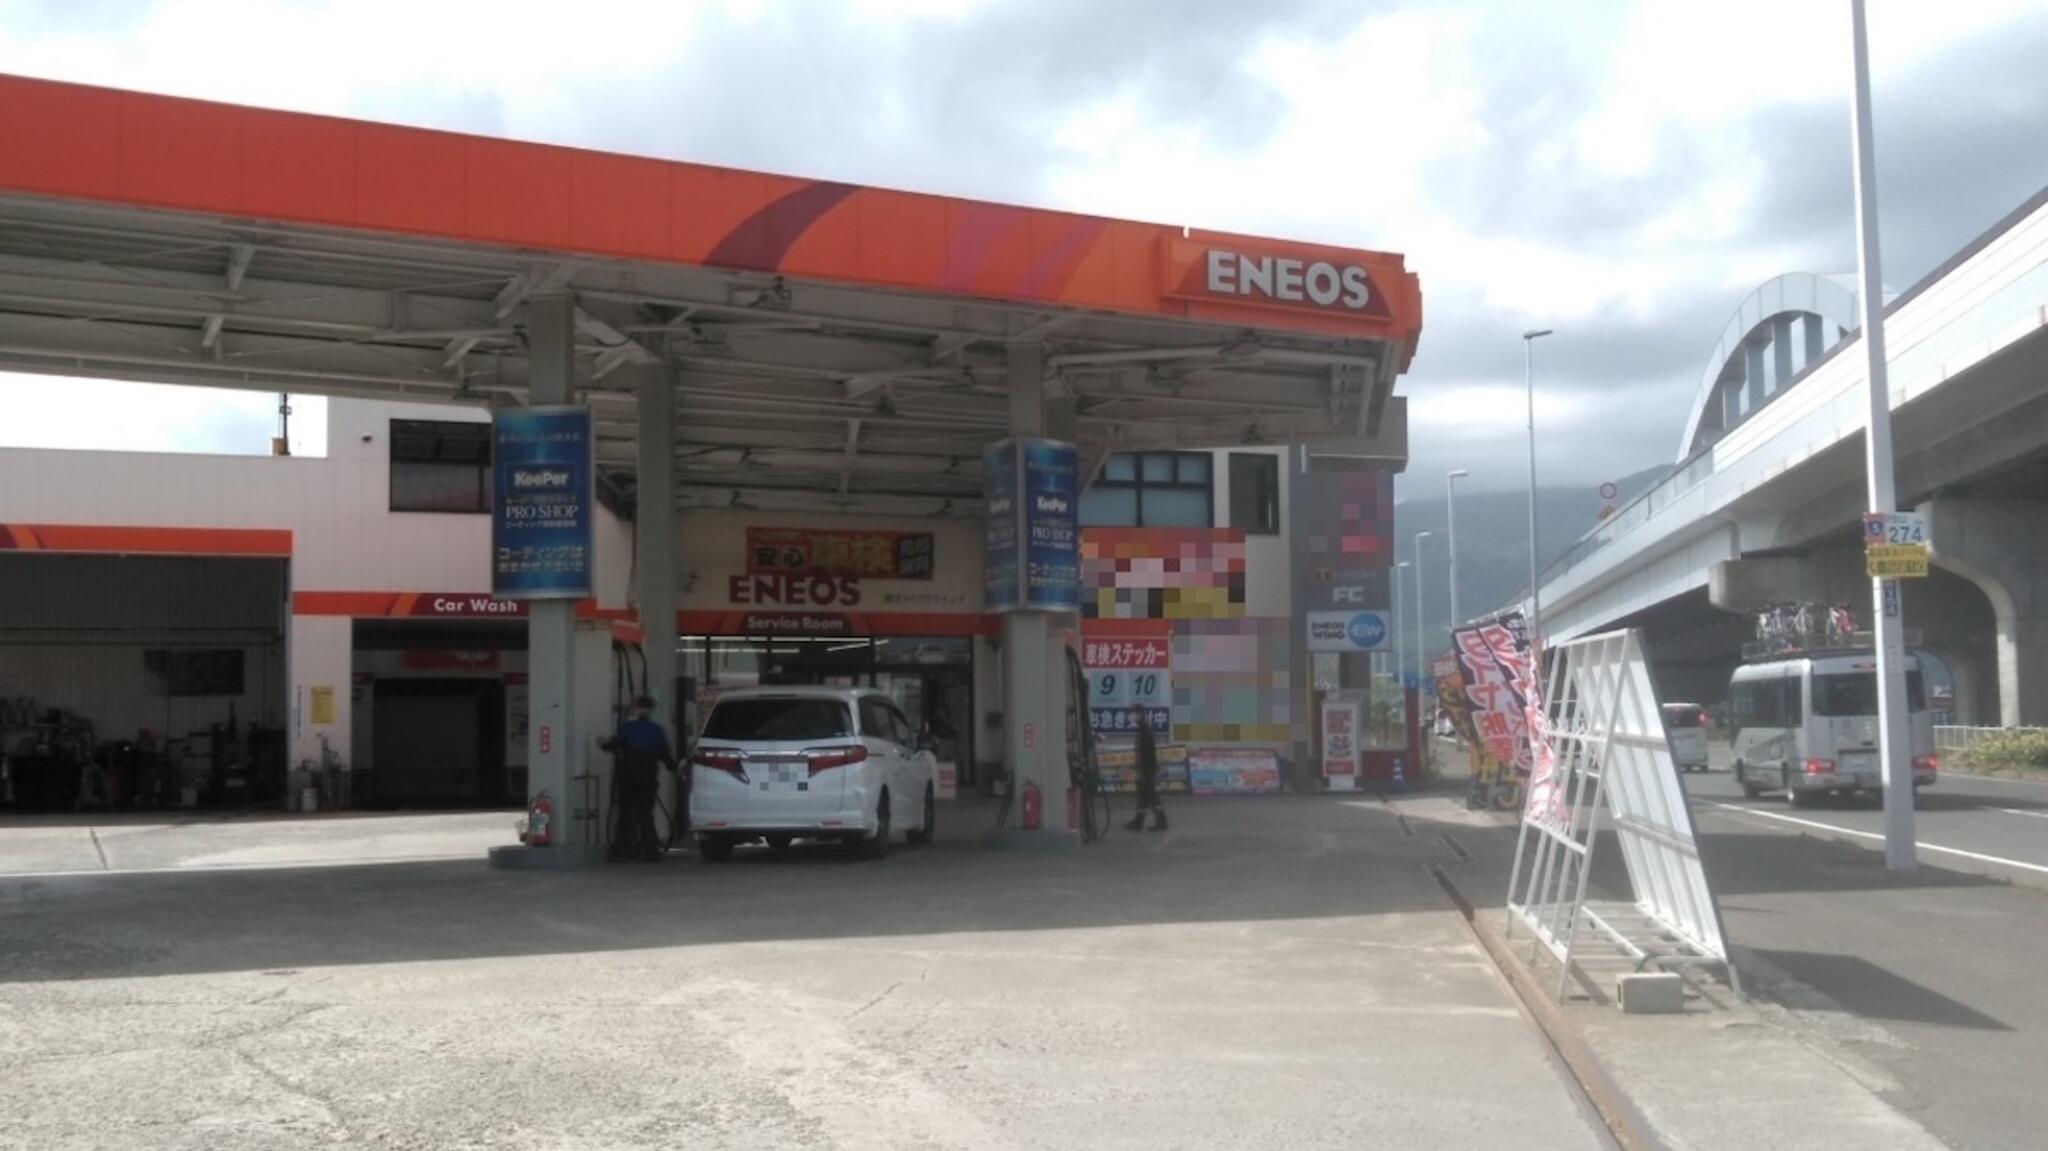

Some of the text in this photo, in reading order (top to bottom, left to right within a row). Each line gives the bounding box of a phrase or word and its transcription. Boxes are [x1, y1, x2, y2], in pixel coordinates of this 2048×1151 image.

[1208, 249, 1369, 309] ENEOS
[513, 471, 569, 488] KeePer
[505, 503, 580, 519] PRO SHOP
[1888, 525, 1923, 544] 274
[728, 575, 862, 606] ENEOS
[1333, 586, 1364, 603] FC
[433, 598, 518, 612] Car Wash
[747, 615, 843, 630] Service Room
[1311, 621, 1345, 630] ENEOS
[1312, 630, 1345, 640] WING
[1085, 641, 1167, 666] 車検ステッカー
[1099, 674, 1157, 696] 9 10
